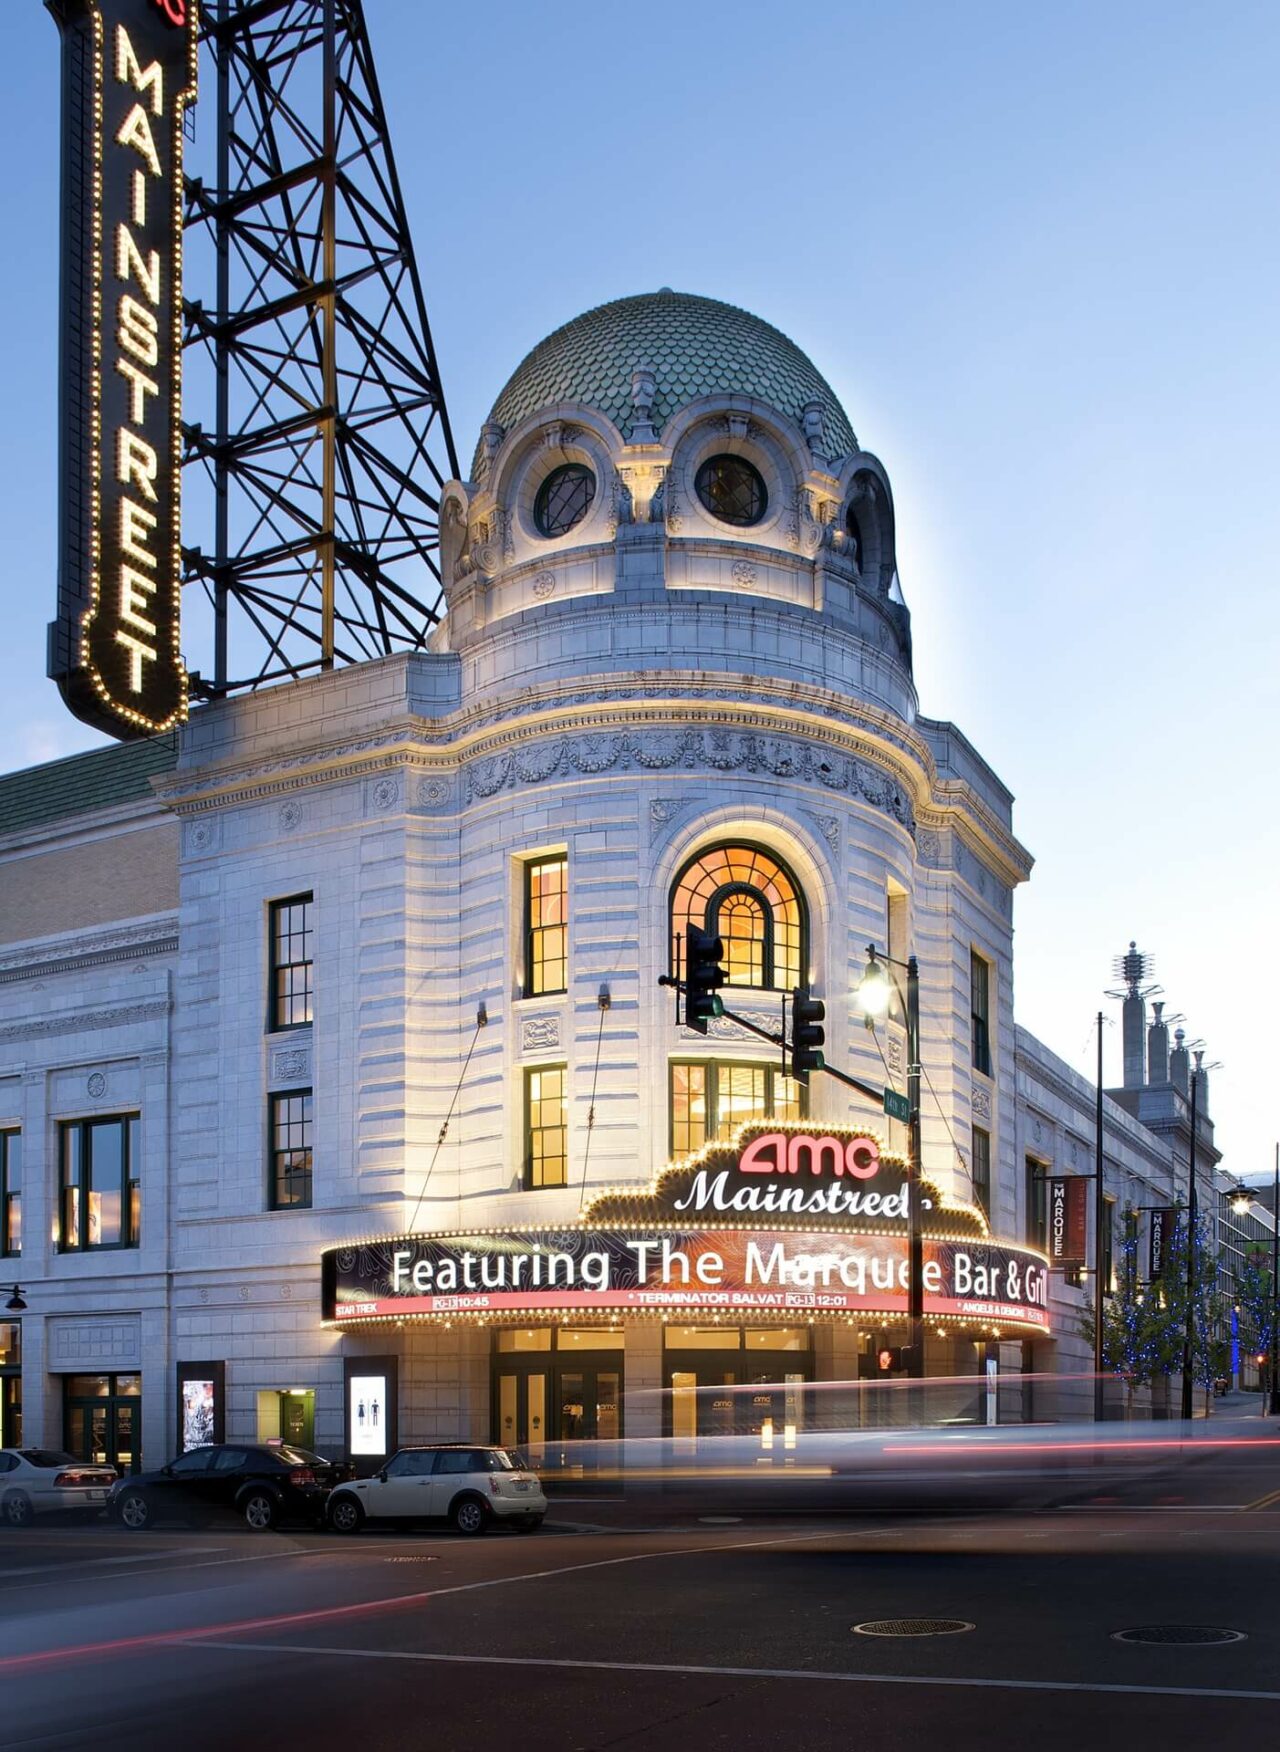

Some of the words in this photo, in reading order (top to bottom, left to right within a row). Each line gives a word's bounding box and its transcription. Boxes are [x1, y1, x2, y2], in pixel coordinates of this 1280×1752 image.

[115, 24, 164, 694] MAINSTREET
[1054, 1188, 1065, 1257] MARQUEE
[1153, 1217, 1162, 1271] MARQUEE
[393, 1244, 610, 1293] Featuring
[626, 1240, 723, 1286] The
[745, 1242, 941, 1295] Marquee
[954, 1253, 1000, 1297] Bar
[1006, 1260, 1021, 1300] &
[336, 1304, 355, 1317] STAR
[356, 1302, 377, 1314] TREK
[458, 1296, 489, 1308] 10:45
[637, 1293, 730, 1304] TERMINATOR
[732, 1293, 784, 1305] SALVAT
[786, 1292, 815, 1307] PG-13
[817, 1295, 847, 1306] 12:01
[962, 1303, 993, 1315] ANGELS
